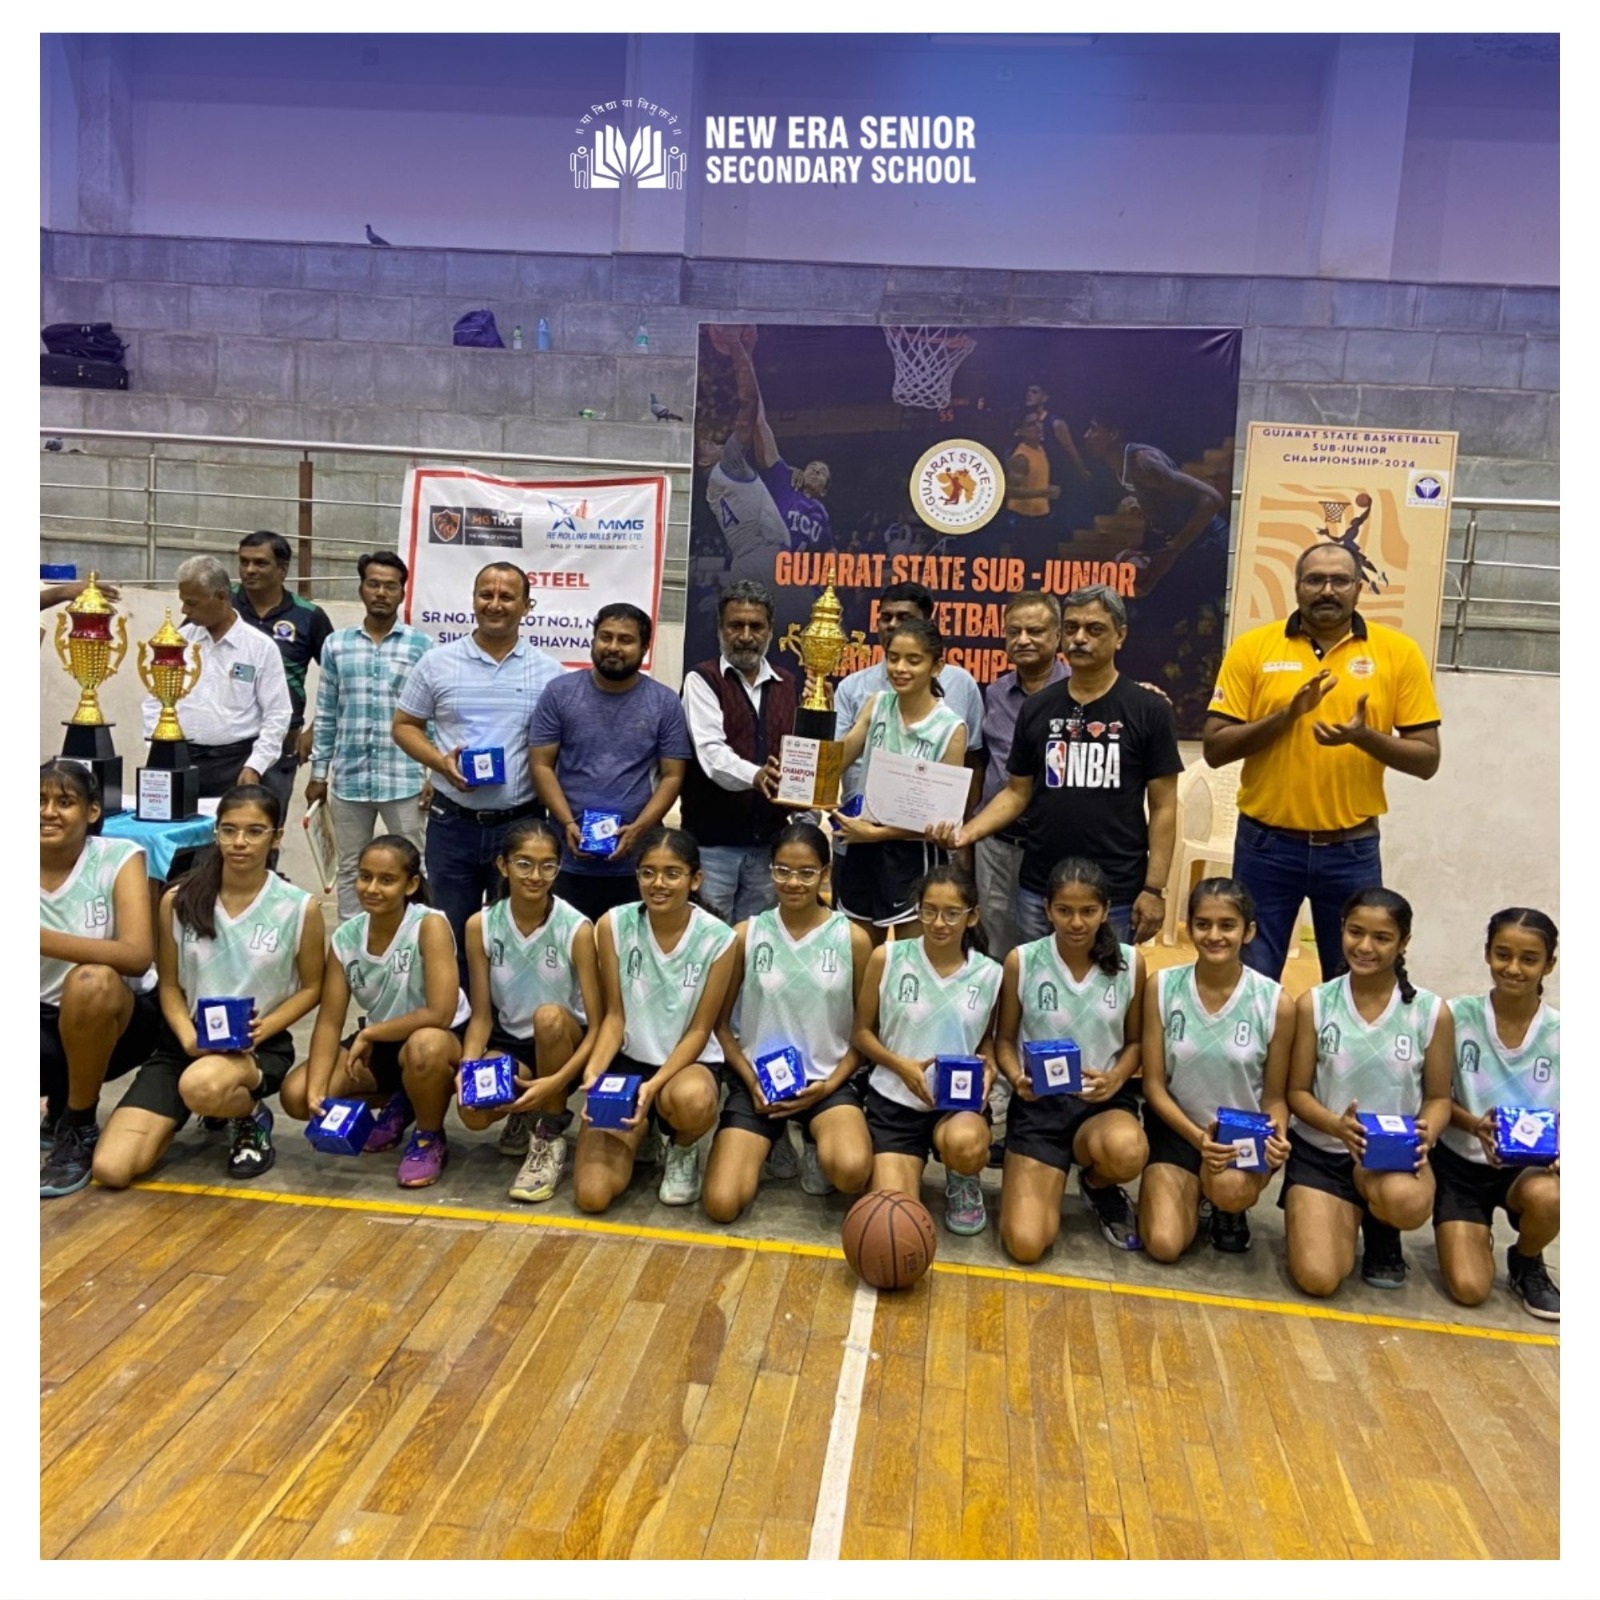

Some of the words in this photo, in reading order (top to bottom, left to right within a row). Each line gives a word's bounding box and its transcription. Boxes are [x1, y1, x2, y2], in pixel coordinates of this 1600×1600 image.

[1262, 429, 1317, 440] GUJARAT
[1322, 432, 1359, 441] STATE
[1363, 433, 1441, 445] BASKETBALL
[1312, 443, 1387, 455] SUB-JUNIOR
[1282, 453, 1416, 468] CHAMPIONSHIP-2024
[922, 451, 955, 506] GUJARAT
[958, 452, 991, 486] STATE
[558, 532, 587, 540] ROLLING
[598, 520, 645, 530] MMG
[787, 510, 822, 542] TCU
[527, 571, 589, 587] STEEL
[775, 551, 886, 588] GUJARAT
[891, 555, 966, 591] STATE
[971, 557, 1025, 593] SUB
[422, 611, 441, 623] SR
[548, 616, 582, 628] NO.1,
[529, 635, 590, 648] BHAVNA
[783, 767, 815, 777] CHAMPION
[1067, 741, 1120, 788] NBA
[84, 896, 109, 928] 15
[250, 923, 279, 952] 14
[393, 947, 411, 974] 13
[822, 948, 837, 972] 11
[684, 962, 703, 987] 12
[968, 985, 981, 1010] 7
[1104, 984, 1117, 1008] 4
[1235, 1020, 1251, 1047] 8
[1395, 1033, 1412, 1061] 9
[1533, 1056, 1552, 1082] 6
